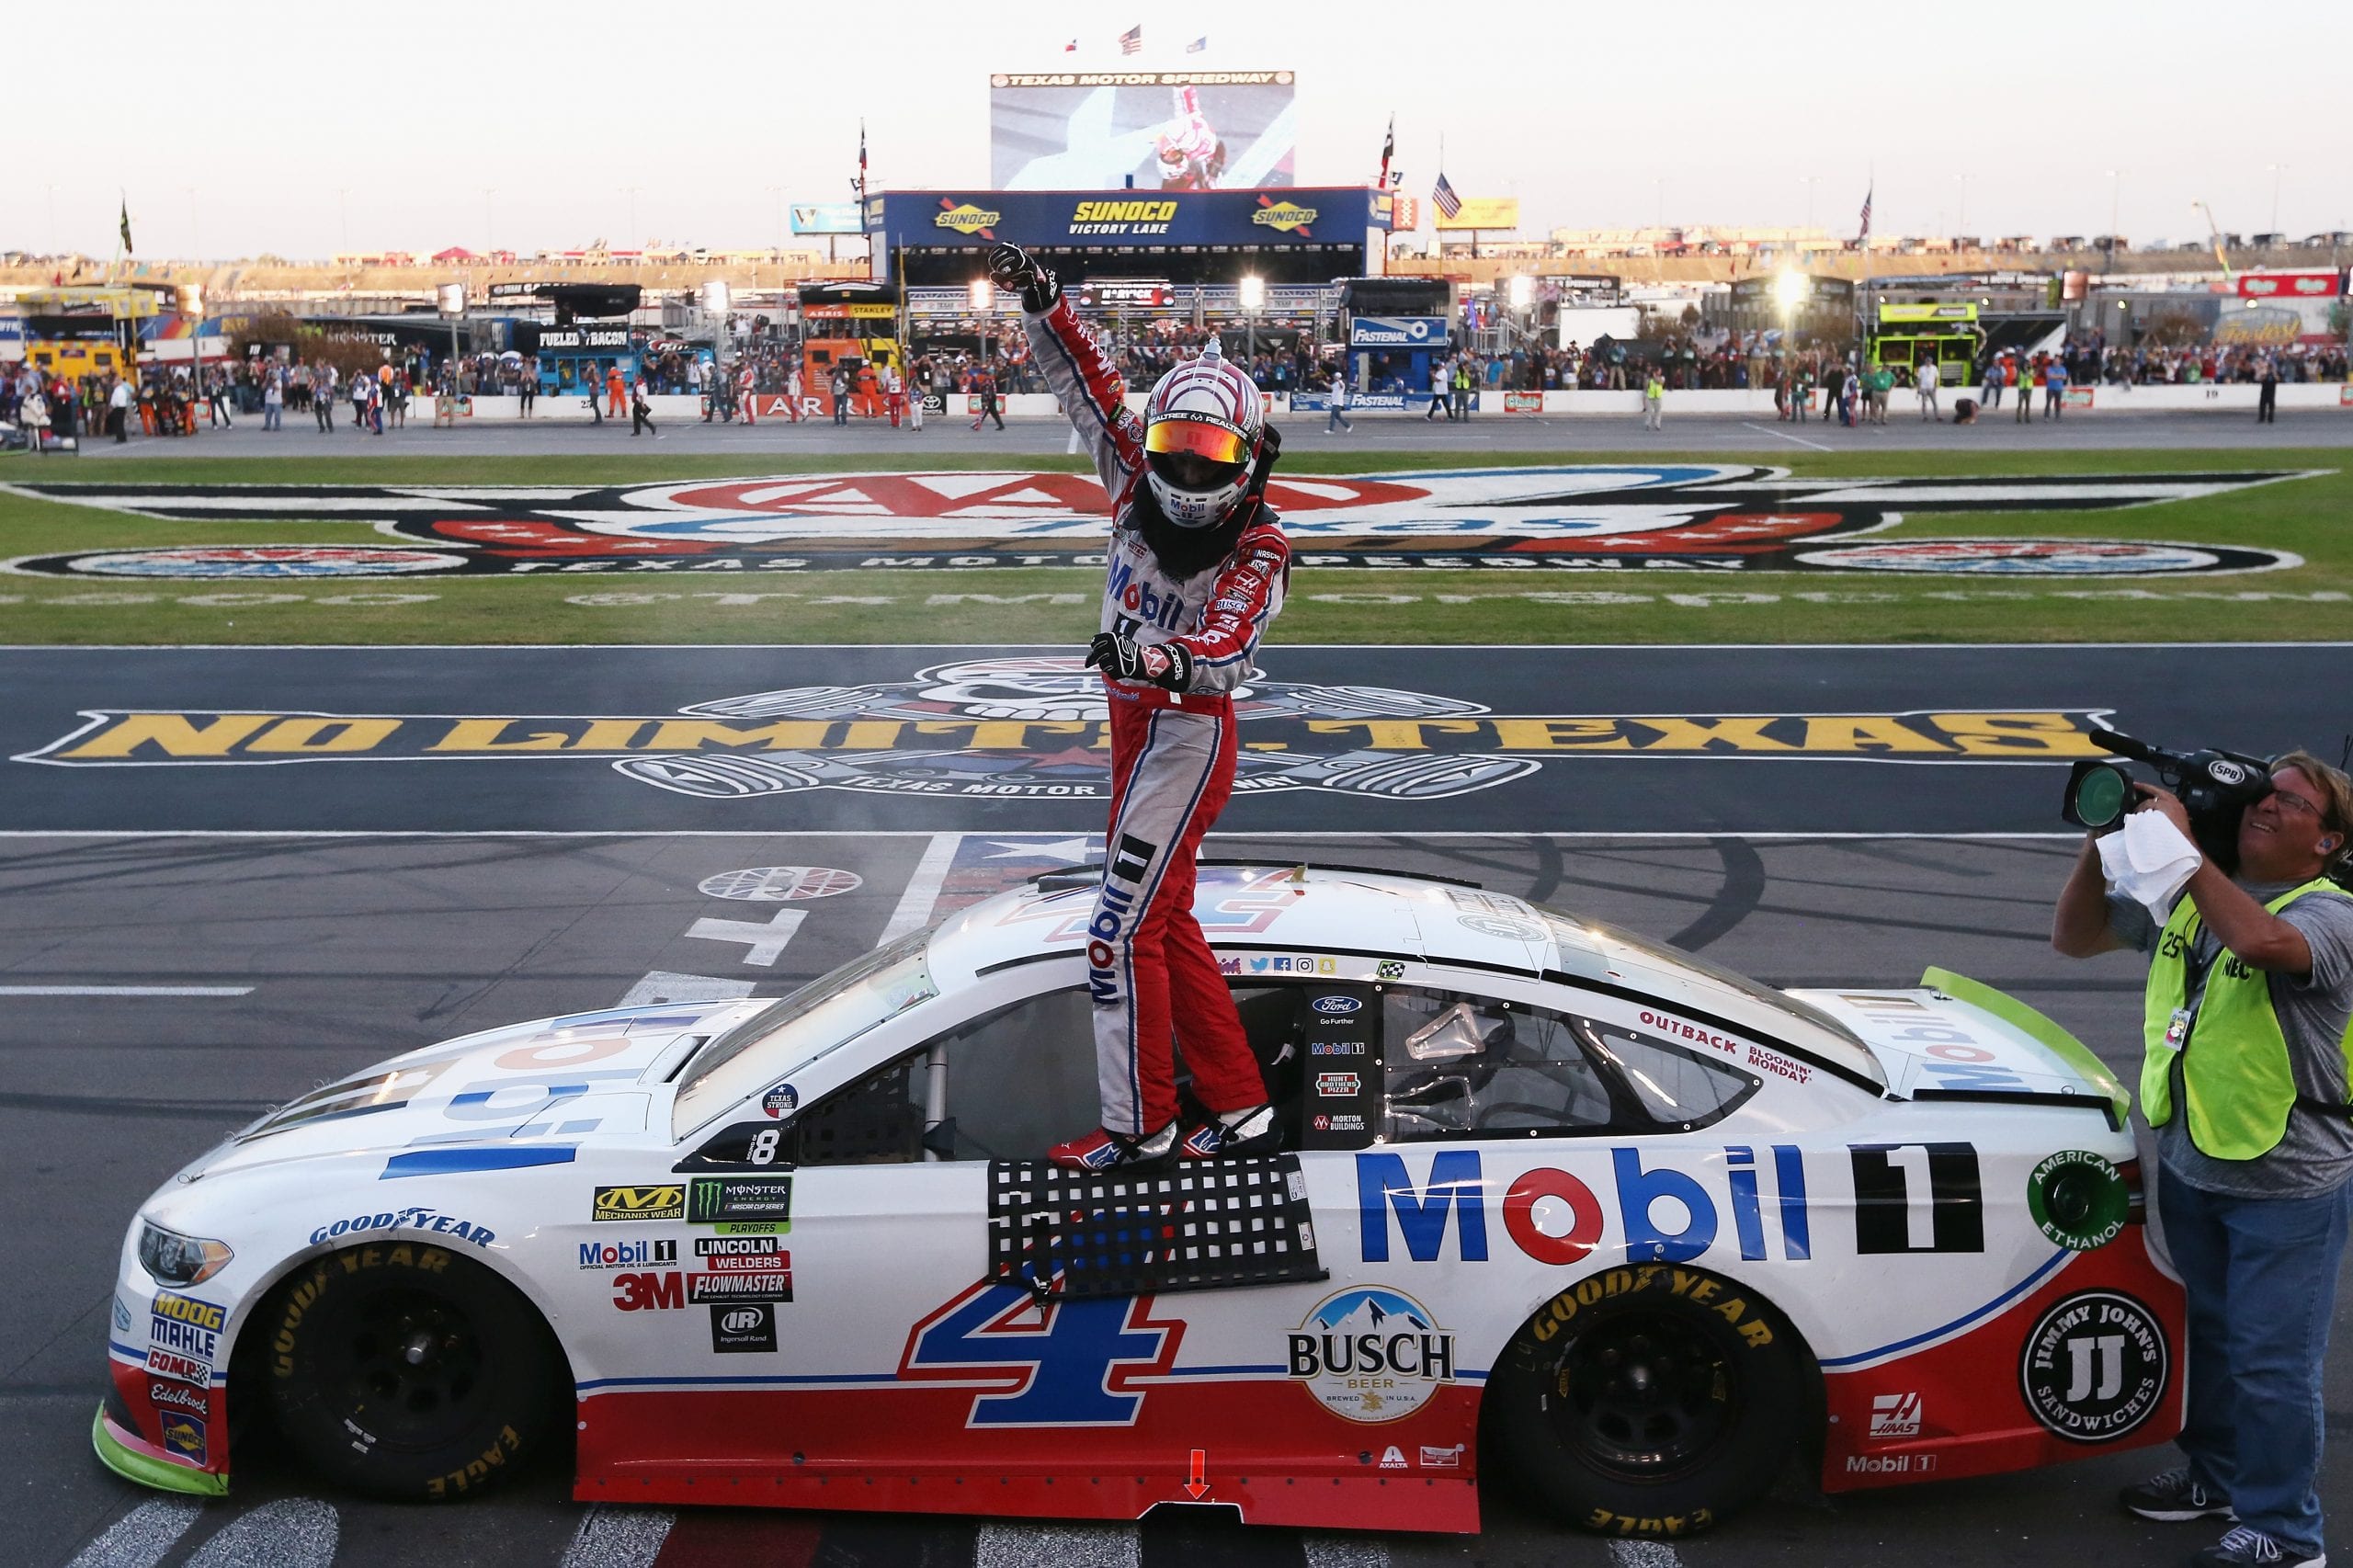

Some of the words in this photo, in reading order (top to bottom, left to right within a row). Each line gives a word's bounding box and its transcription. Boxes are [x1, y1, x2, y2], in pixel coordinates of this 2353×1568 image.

[1010, 75, 1075, 85] TEXAS
[1080, 74, 1156, 85] MOTOR
[1161, 73, 1274, 85] SPEEDWAY
[938, 213, 997, 225] SUNOCO
[1074, 201, 1177, 222] SUNOCO
[1256, 210, 1315, 222] SUNOCO
[1069, 223, 1128, 234] VICTORY
[1132, 223, 1169, 234] LANE
[540, 331, 580, 347] FUELED
[1205, 416, 1248, 441] REALTREE
[1170, 498, 1206, 513] Mobil
[510, 557, 808, 573] TEXAS
[861, 554, 1109, 570] MOTO
[1298, 554, 1745, 570] PEEDWAY
[1108, 553, 1186, 631] Mobil
[1214, 598, 1249, 613] BUSCH
[52, 714, 404, 757] NO
[1305, 713, 2115, 756] TEXAS
[839, 774, 951, 792] TEXAS
[961, 782, 1096, 796] MOTOR
[1087, 883, 1133, 1006] Mobil
[2161, 932, 2185, 959] 25
[1322, 998, 1352, 1011] Ford
[1640, 1011, 1738, 1055] OUTBACK
[1313, 1042, 1350, 1055] Mobil
[1749, 1046, 1813, 1076] BLOOMIN'
[1748, 1054, 1811, 1085] MONDAY
[1330, 1122, 1365, 1131] BUILDINGS
[752, 1130, 780, 1165] 8
[2033, 1151, 2120, 1185] AMERICAN
[726, 1185, 787, 1195] MONSTER
[596, 1210, 649, 1221] MECHANIX
[651, 1208, 682, 1219] WEAR
[1355, 1143, 1812, 1266] Mobil
[310, 1208, 495, 1249] GOODYEAR
[730, 1223, 777, 1233] PLAYOFFS
[2041, 1218, 2125, 1250] ETHANOL
[580, 1241, 648, 1265] Mobil
[699, 1239, 773, 1256] LINCOLN
[715, 1256, 782, 1269] WELDERS
[613, 1271, 686, 1312] 3M
[693, 1274, 784, 1300] FLOWMASTER
[153, 1293, 224, 1329] MOOG
[895, 1202, 1192, 1429] 4
[1533, 1265, 1774, 1349] GOODYEAR
[728, 1312, 756, 1329] IR
[151, 1316, 215, 1358] MAHLE
[2035, 1304, 2091, 1369] JIMMY
[2099, 1304, 2157, 1365] JOHN'S
[148, 1350, 198, 1376] COMP
[1288, 1333, 1456, 1382] BUSCH
[2067, 1335, 2125, 1403] JJ
[1347, 1379, 1394, 1389] BEER
[151, 1383, 208, 1415] Edelbrock
[2038, 1377, 2155, 1432] SANDWICHES
[165, 1427, 204, 1449] SUNOCO
[1876, 1423, 1915, 1434] HAAS
[426, 1425, 522, 1498] EAGLE
[1847, 1455, 1910, 1471] Mobil
